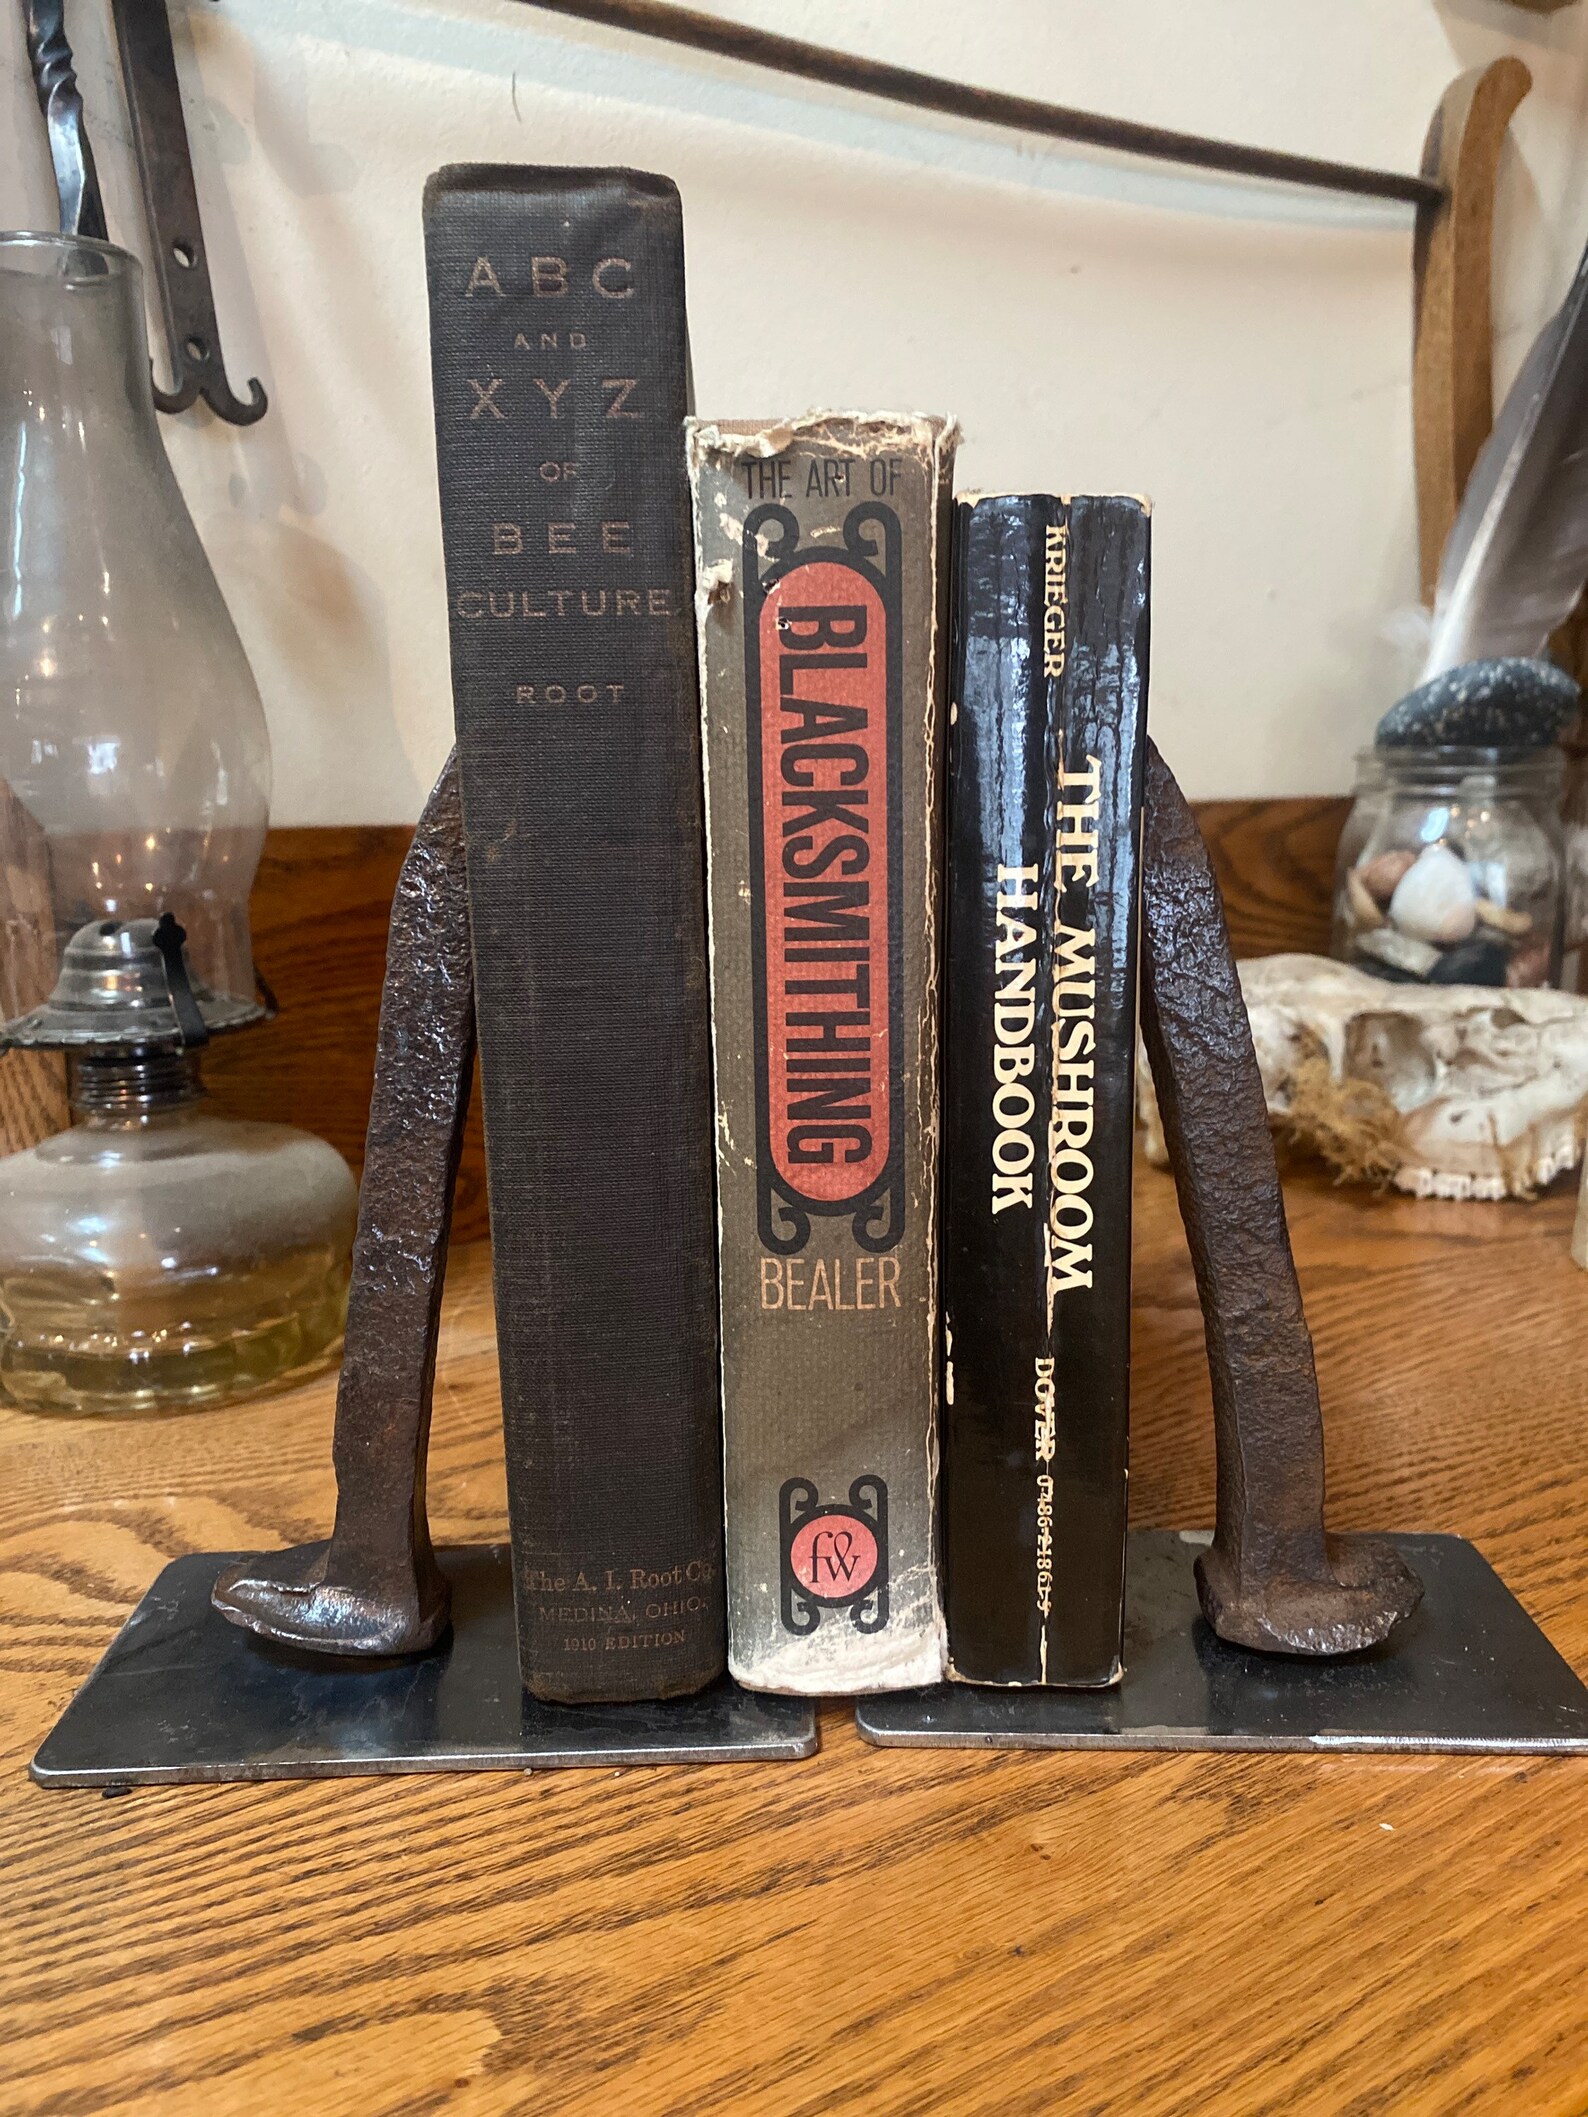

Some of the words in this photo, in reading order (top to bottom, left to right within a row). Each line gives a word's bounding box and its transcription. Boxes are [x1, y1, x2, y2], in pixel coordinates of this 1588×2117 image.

[513, 332, 587, 351] AND
[538, 461, 580, 483] OF
[741, 458, 793, 500] THE
[806, 458, 856, 498] ART
[869, 458, 903, 497] OF
[492, 520, 631, 555] BEE
[456, 588, 675, 619] CULTURE
[1043, 523, 1068, 679] KRIEGER
[515, 684, 626, 705] ROOT
[1053, 753, 1103, 893] THE
[778, 603, 874, 1164] BLACKSMITHING
[990, 862, 1040, 1216] HANDBOOK
[1049, 926, 1097, 1295] MUSHROOM
[759, 1256, 902, 1312] BEALER
[1034, 1356, 1057, 1463] DOVER
[525, 1568, 567, 1592] The
[572, 1570, 598, 1592] A.
[629, 1565, 682, 1590] Root
[563, 1637, 597, 1652] 1910
[604, 1629, 687, 1651] EDITION
